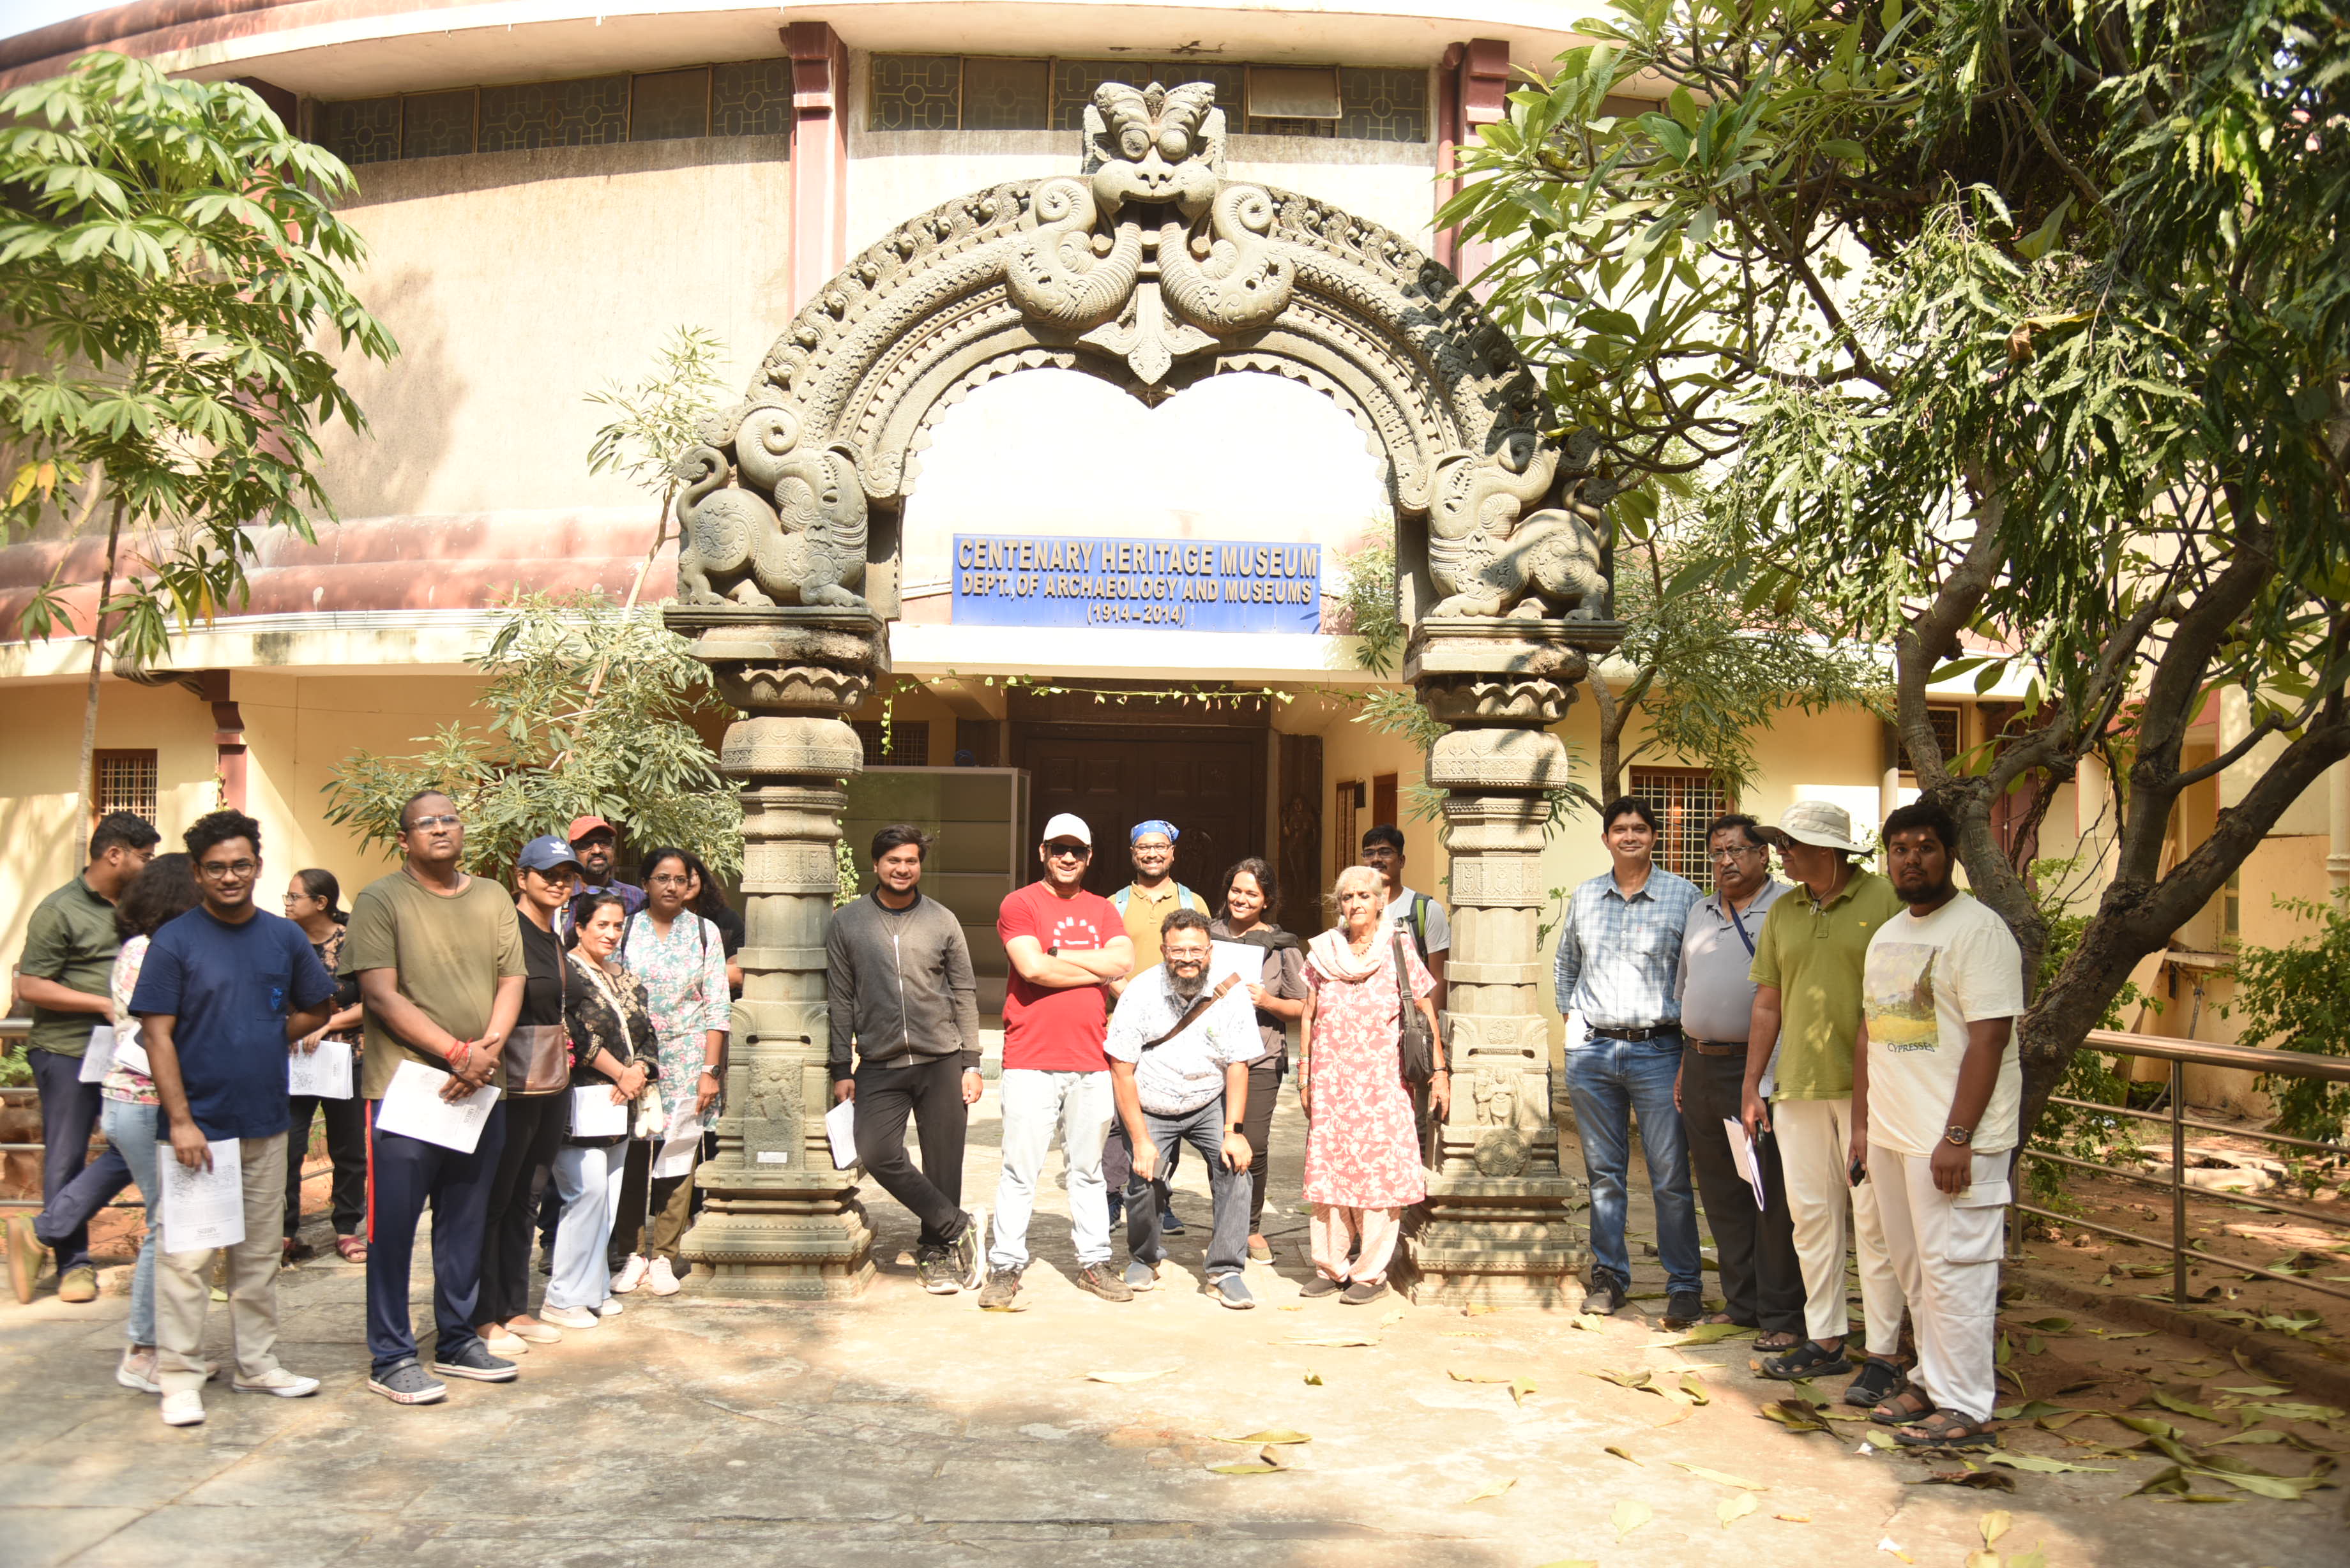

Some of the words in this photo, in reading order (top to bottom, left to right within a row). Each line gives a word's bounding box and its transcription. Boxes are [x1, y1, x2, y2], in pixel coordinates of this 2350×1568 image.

[958, 538, 1094, 573] CENTENARY
[1101, 541, 1213, 576] HERITAGE
[1220, 545, 1317, 578] MUSEUM
[1043, 575, 1178, 601] ARCHAEOLOGY
[1181, 578, 1219, 603] AND
[1224, 580, 1312, 605] MUSEUMS
[1887, 1042, 1936, 1053] CYPRESSES
